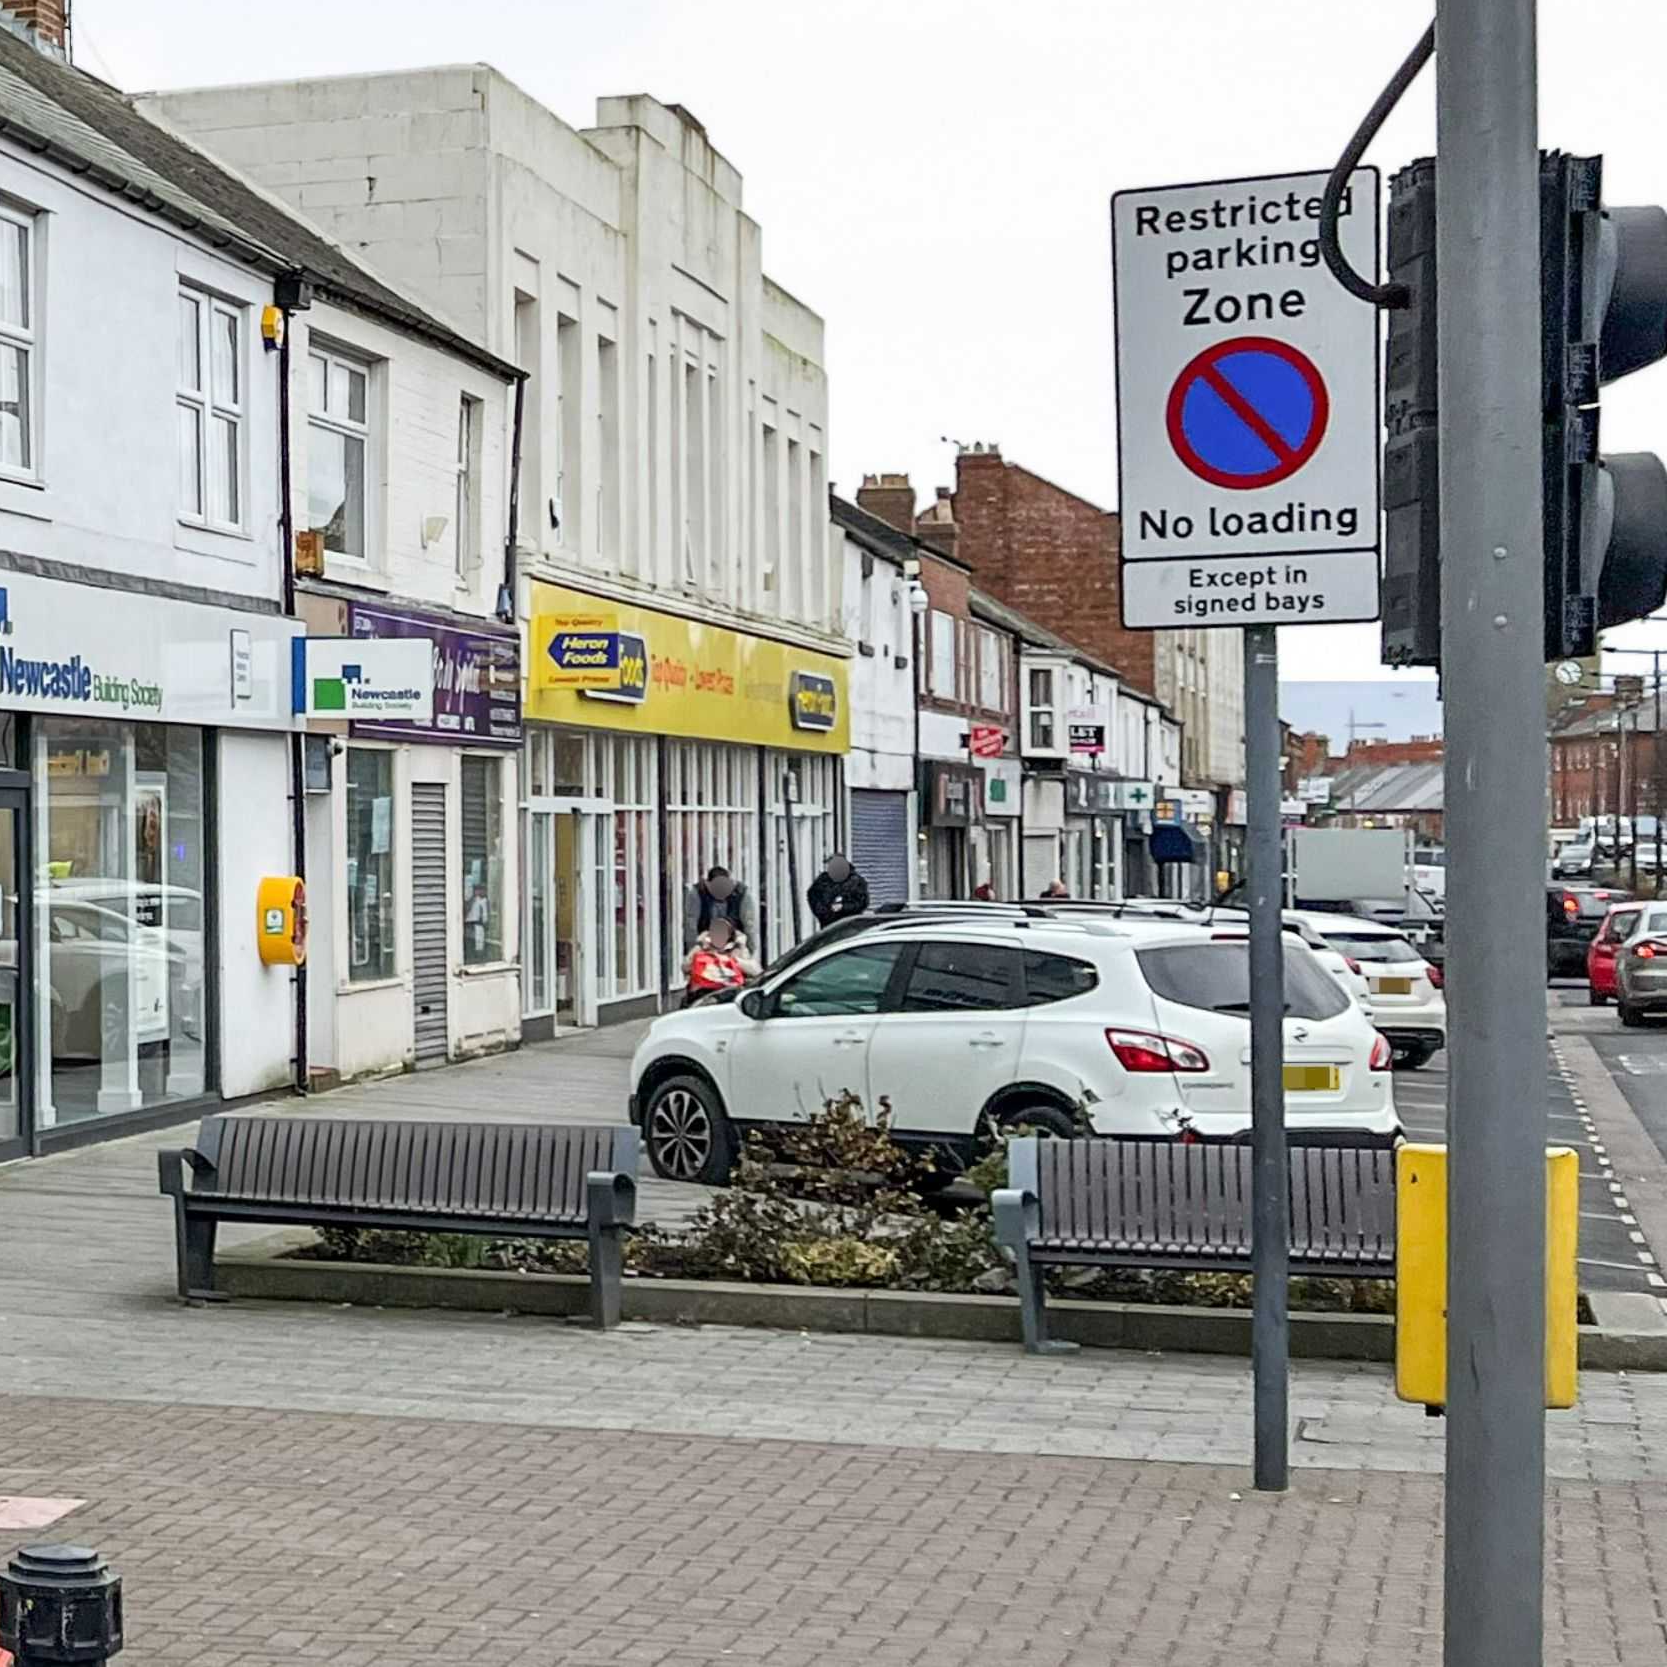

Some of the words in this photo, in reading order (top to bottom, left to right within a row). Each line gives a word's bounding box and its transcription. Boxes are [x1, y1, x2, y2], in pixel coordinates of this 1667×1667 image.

[1165, 238, 1321, 278] parking
[1183, 289, 1306, 327] Zone
[1140, 509, 1194, 540] No
[1208, 502, 1358, 541] loading
[1188, 567, 1278, 590] Except
[1285, 565, 1308, 585] in
[1174, 593, 1256, 617] signed
[1264, 592, 1325, 613] bays
[562, 637, 609, 649] Heron
[563, 651, 608, 664] Foods
[0, 645, 91, 701] Newcastle
[93, 674, 128, 710] Building
[131, 677, 163, 713] Society
[351, 688, 421, 701] Newcastle
